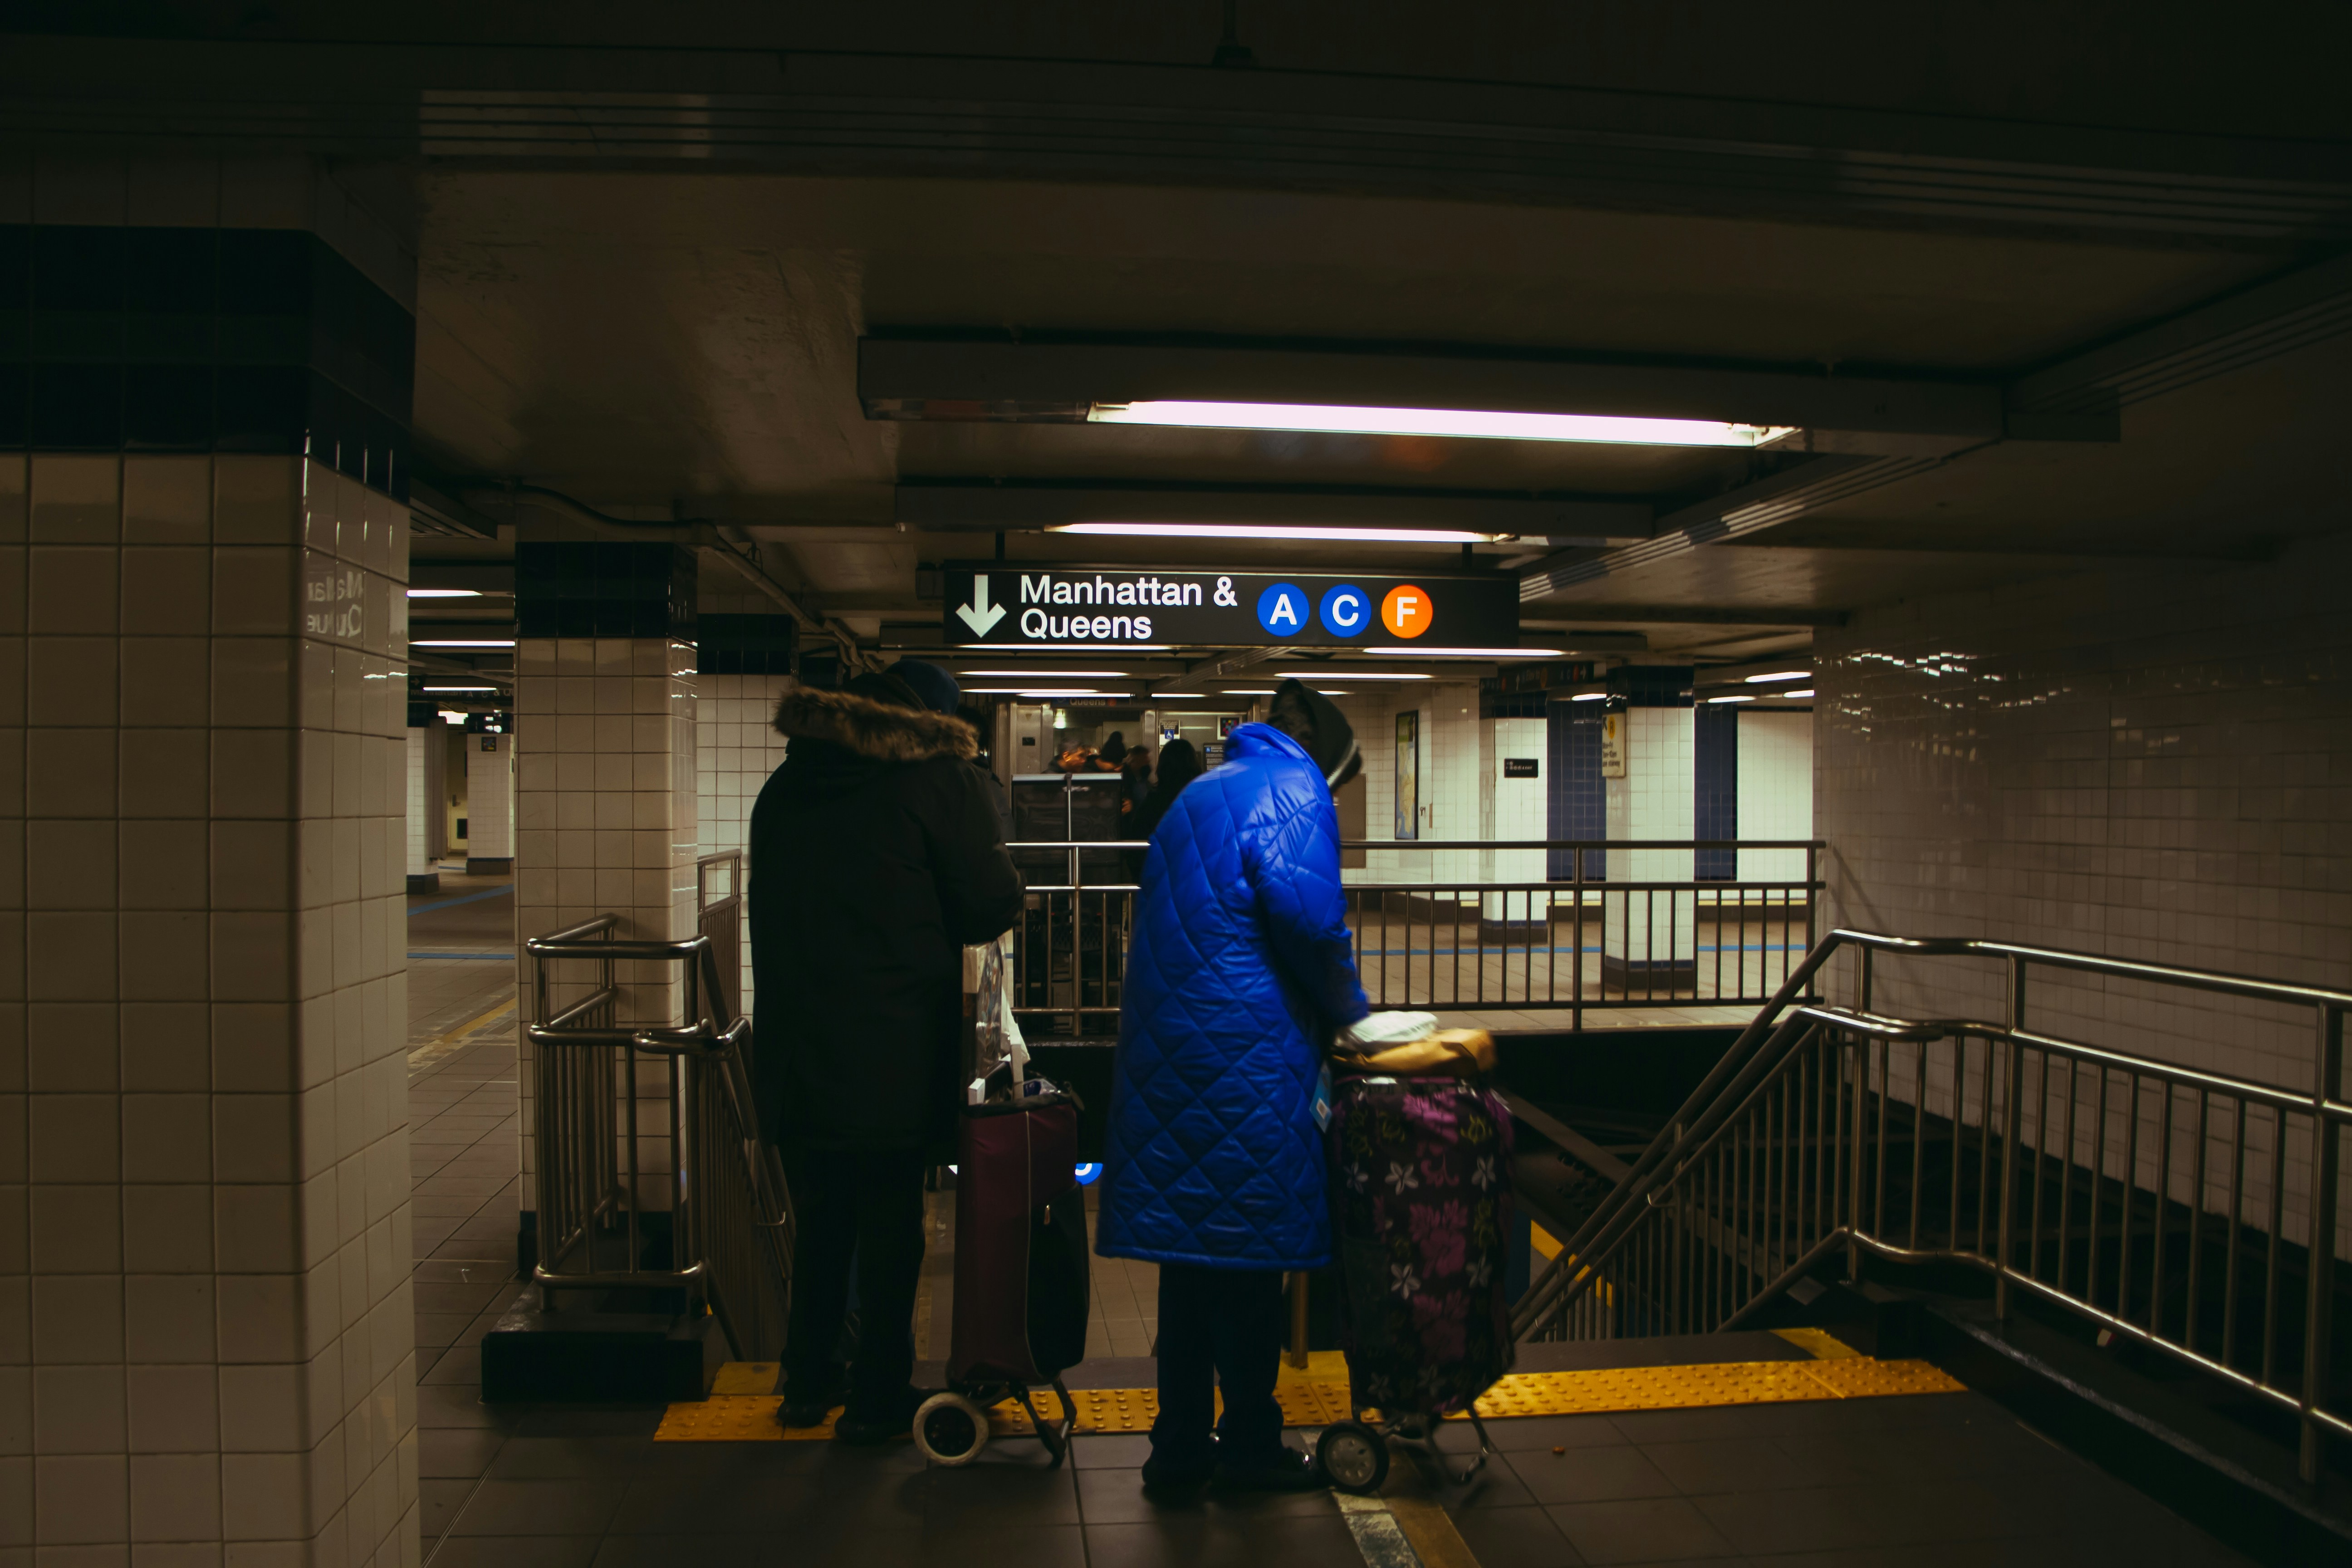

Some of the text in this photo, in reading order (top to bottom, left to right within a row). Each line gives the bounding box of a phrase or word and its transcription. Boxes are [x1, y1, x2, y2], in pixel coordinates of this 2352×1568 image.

[1021, 575, 1238, 606] Manhattan &
[1021, 608, 1152, 639] Queens
[1269, 594, 1417, 627] A C F
[1069, 697, 1106, 706] Queens
